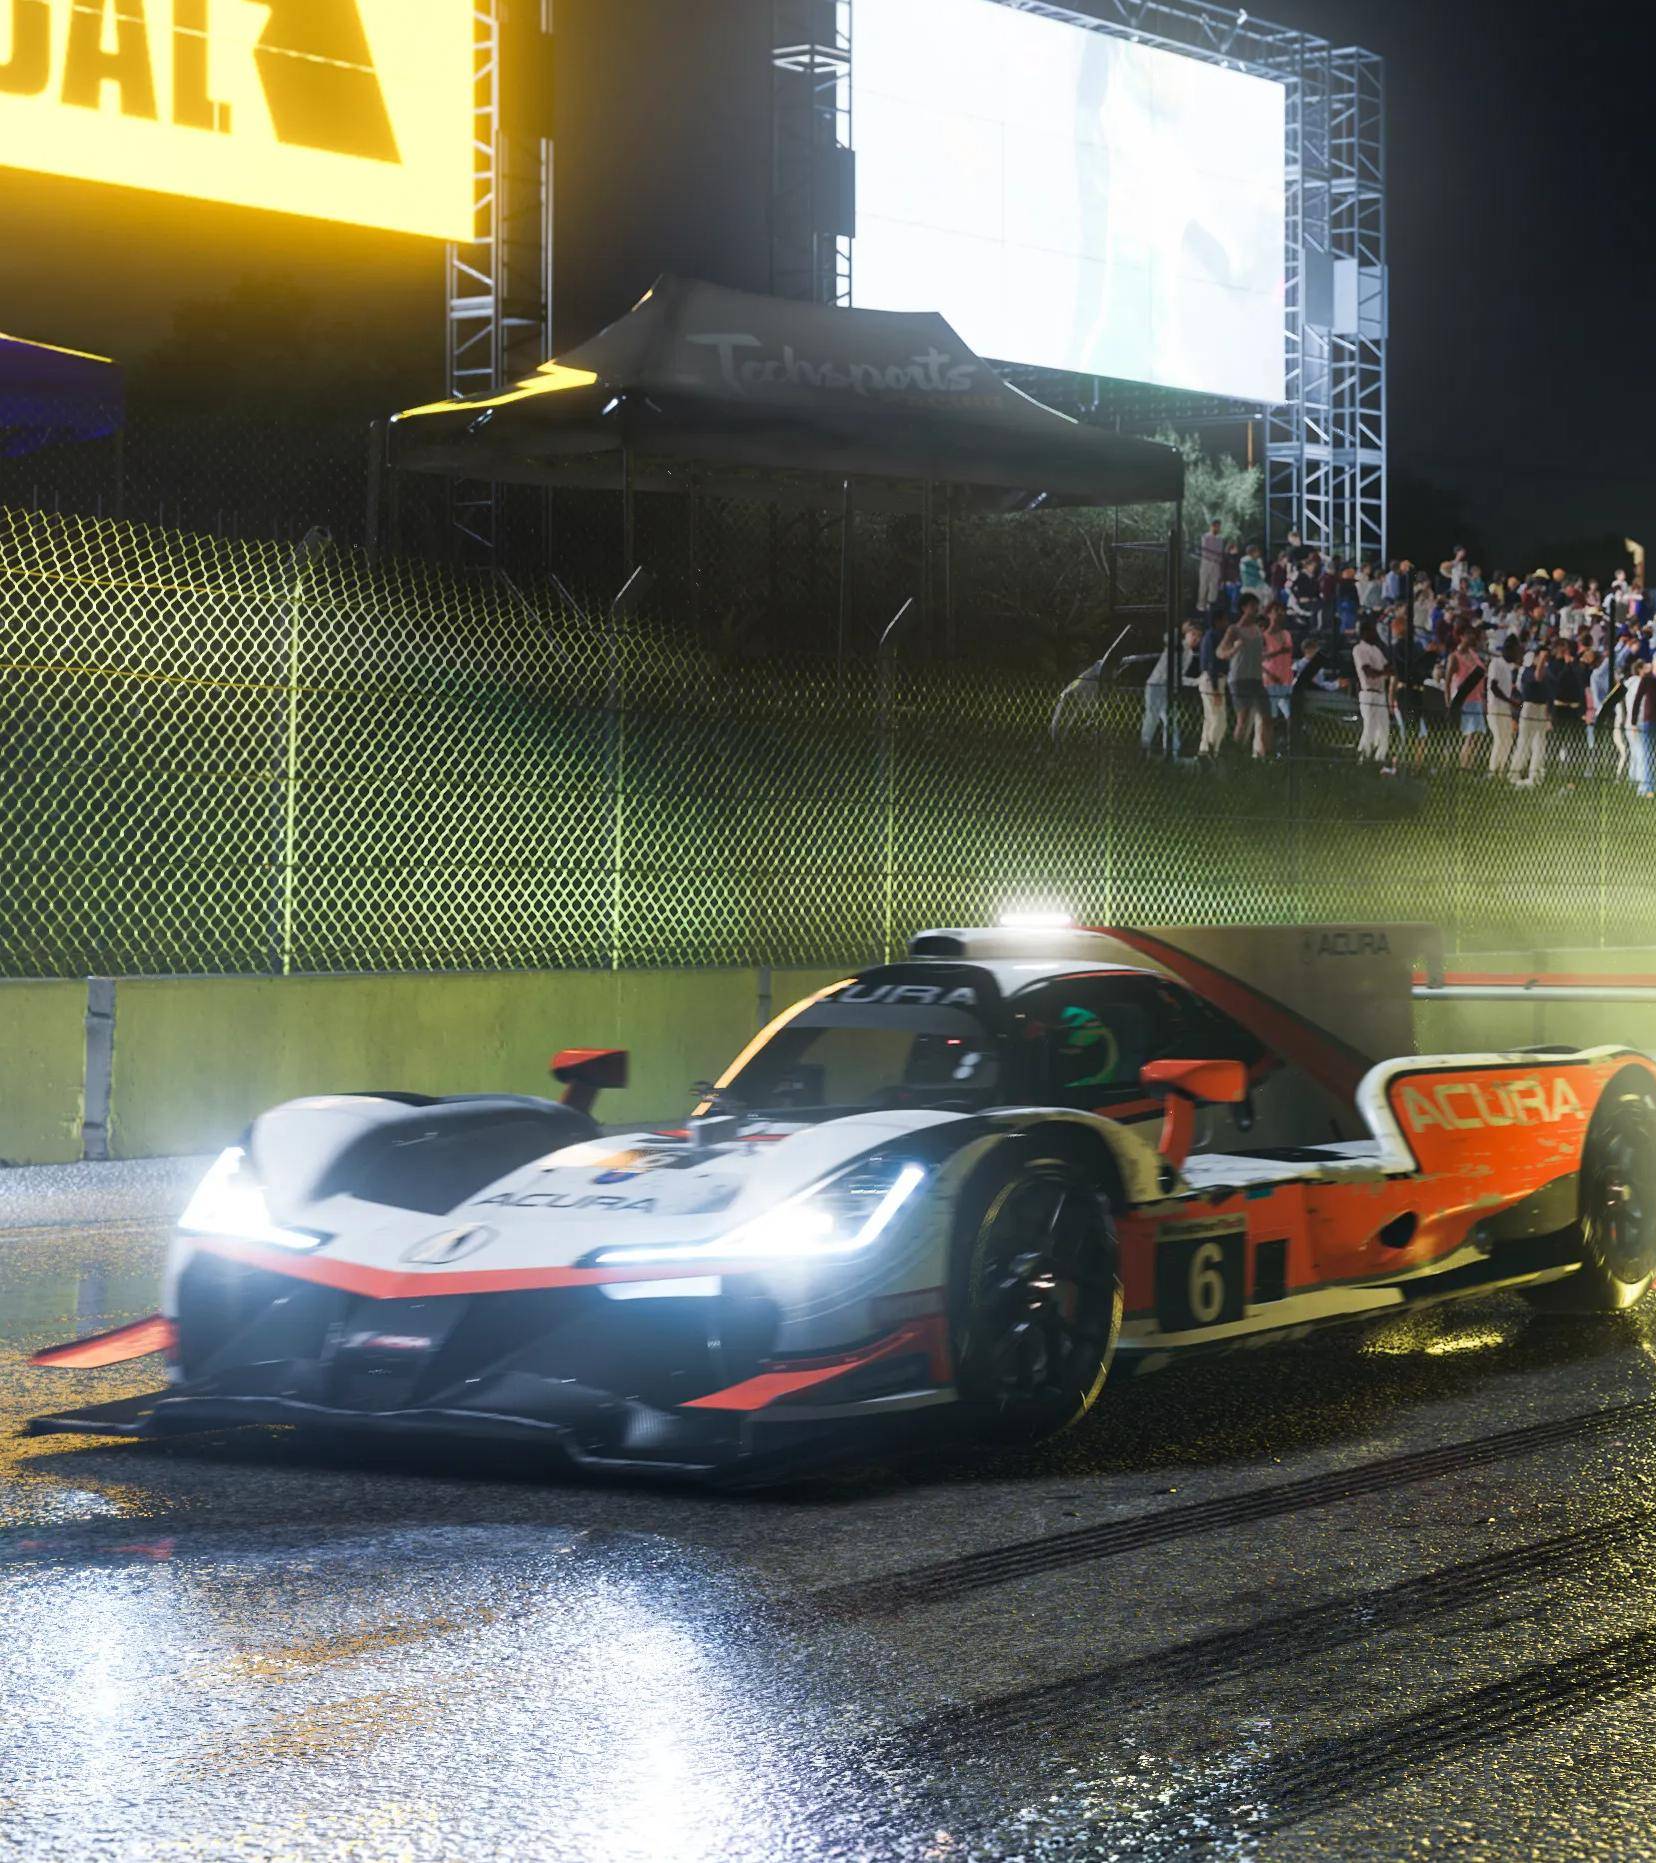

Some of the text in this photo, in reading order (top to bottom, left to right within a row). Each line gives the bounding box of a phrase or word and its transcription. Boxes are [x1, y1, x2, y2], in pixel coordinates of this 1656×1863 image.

[1317, 931, 1391, 957] ACURA
[1402, 1077, 1586, 1133] ACURA
[472, 1192, 656, 1214] ACURA
[1188, 1241, 1225, 1323] 6
